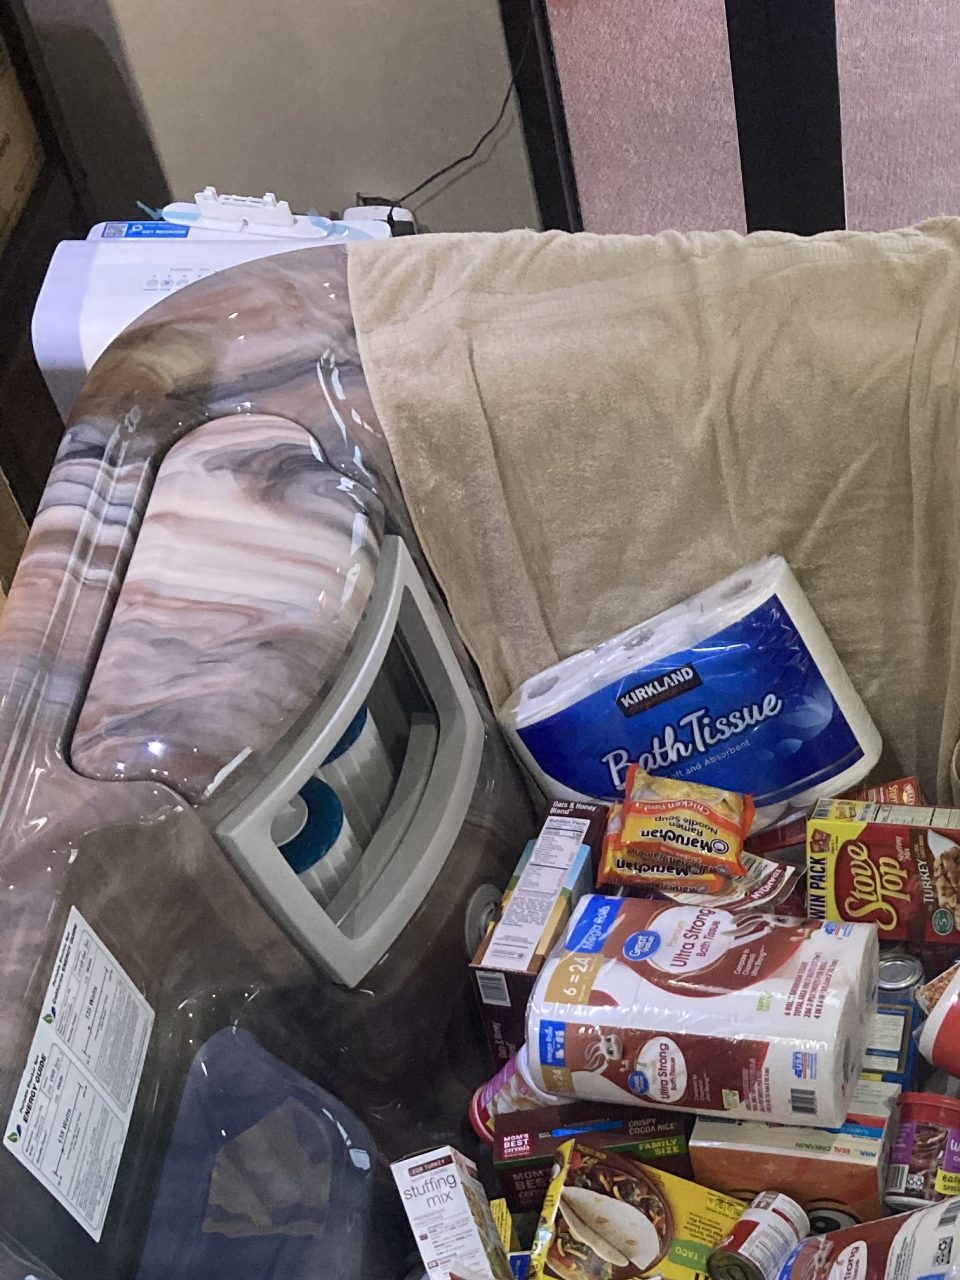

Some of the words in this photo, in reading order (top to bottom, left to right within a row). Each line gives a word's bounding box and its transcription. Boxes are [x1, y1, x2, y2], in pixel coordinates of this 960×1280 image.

[620, 666, 695, 709] KIRKLAND
[602, 728, 693, 790] Bath
[688, 692, 783, 753] Tissue
[685, 759, 703, 775] and
[703, 740, 752, 768] Absorbent
[550, 807, 570, 815] Blend
[553, 801, 569, 809] Oats
[575, 802, 597, 812] Honey
[672, 802, 712, 817] Chicken
[655, 815, 681, 825] Soup
[668, 821, 703, 836] Ramen
[685, 817, 718, 837] Noodle
[641, 829, 718, 854] Maruchan
[616, 859, 690, 877] Maruchan
[809, 856, 826, 890] PACK
[845, 840, 871, 918] Stove
[920, 857, 936, 905] TURKEY
[876, 856, 911, 931] Top
[809, 892, 826, 919] WIN
[582, 926, 602, 950] Mega
[594, 905, 611, 927] Rolls
[671, 936, 694, 968] Ultra
[687, 906, 717, 937] Strong
[700, 919, 721, 941] Tissue
[629, 934, 648, 957] Great
[697, 941, 709, 957] Bath
[569, 955, 592, 976] 24
[88, 986, 98, 1004] Watts
[658, 1043, 670, 1077] Strong
[23, 1085, 38, 1123] ENERGY
[35, 1054, 47, 1083] GUIDE
[659, 1078, 670, 1099] Ultra
[628, 1117, 657, 1128] CRISPY
[628, 1124, 654, 1136] COCOA
[655, 1121, 676, 1132] RICE
[504, 1133, 529, 1142] MOM'S
[504, 1139, 529, 1148] BEST
[639, 1138, 677, 1152] FAMILY
[653, 1144, 680, 1156] SIZE
[412, 1165, 424, 1174] FOR
[424, 1158, 446, 1170] TURKEY
[403, 1173, 458, 1201] stuffing
[426, 1190, 454, 1208] mix
[674, 1246, 698, 1261] TACO
